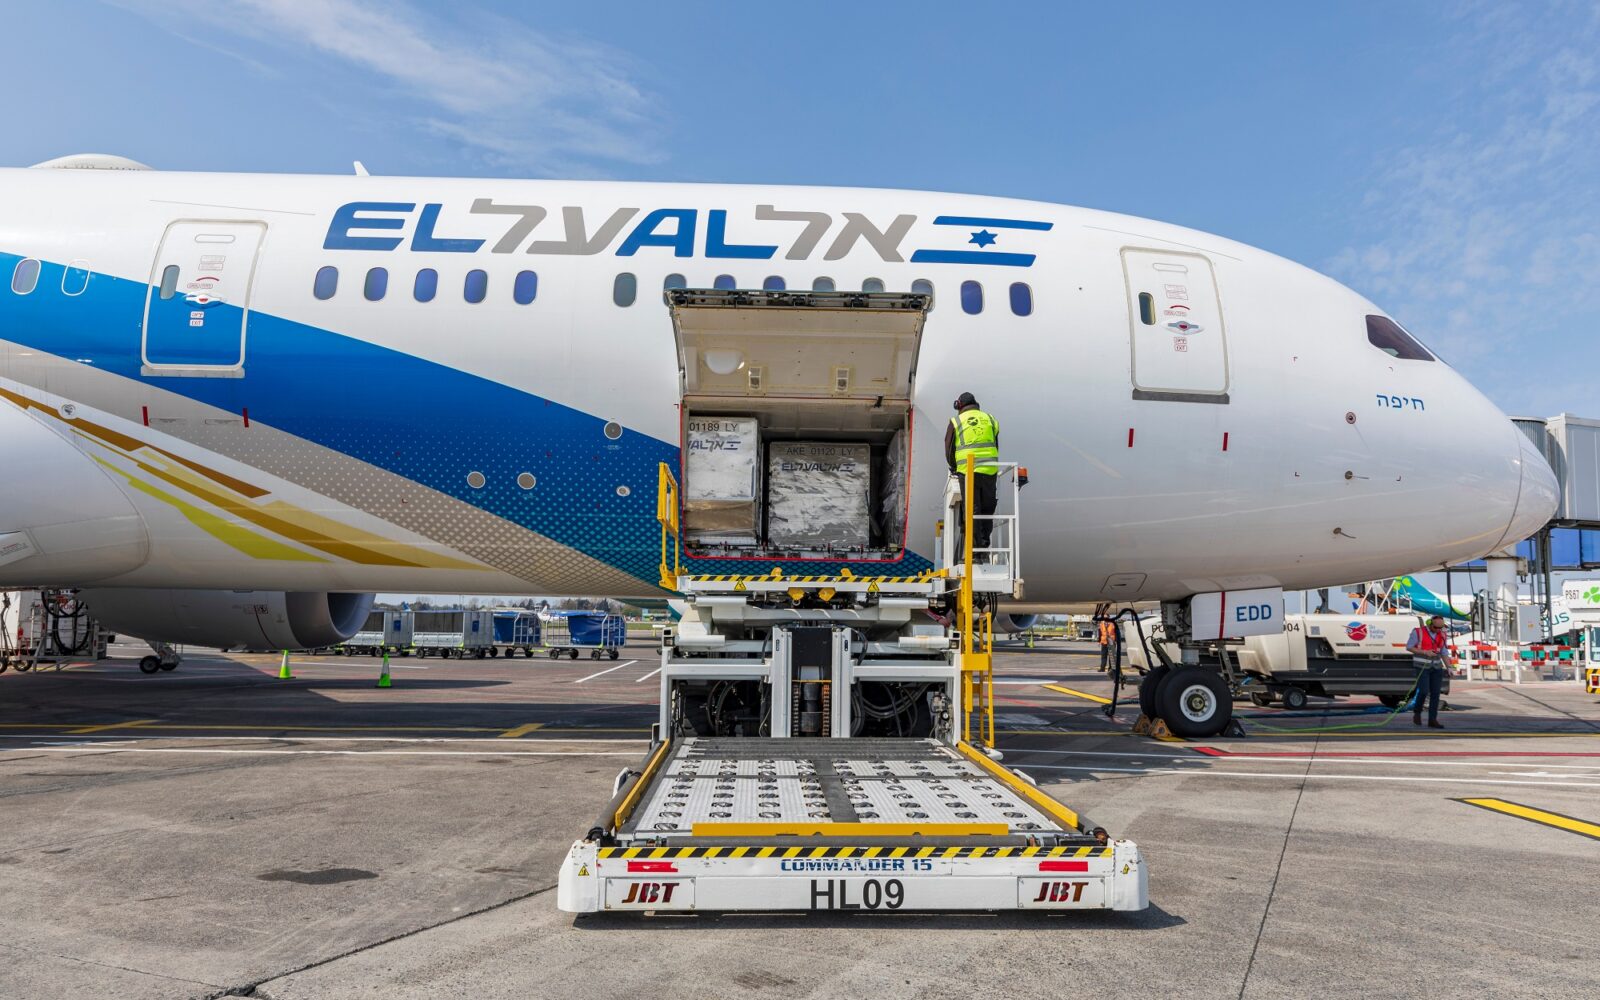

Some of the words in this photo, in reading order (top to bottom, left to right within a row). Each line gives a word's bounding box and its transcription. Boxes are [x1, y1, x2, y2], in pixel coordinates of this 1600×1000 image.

[1376, 394, 1425, 411] חיפה
[689, 422, 720, 432] 01189
[725, 423, 738, 432] LY
[786, 447, 805, 456] AKE
[810, 447, 836, 456] 01120
[841, 447, 853, 456] LY
[1236, 604, 1272, 622] EDD
[781, 858, 905, 871] COMMANDER
[911, 858, 932, 871] 15
[621, 882, 680, 903] JBT
[810, 878, 905, 909] HL09
[1033, 881, 1089, 902] JBT
